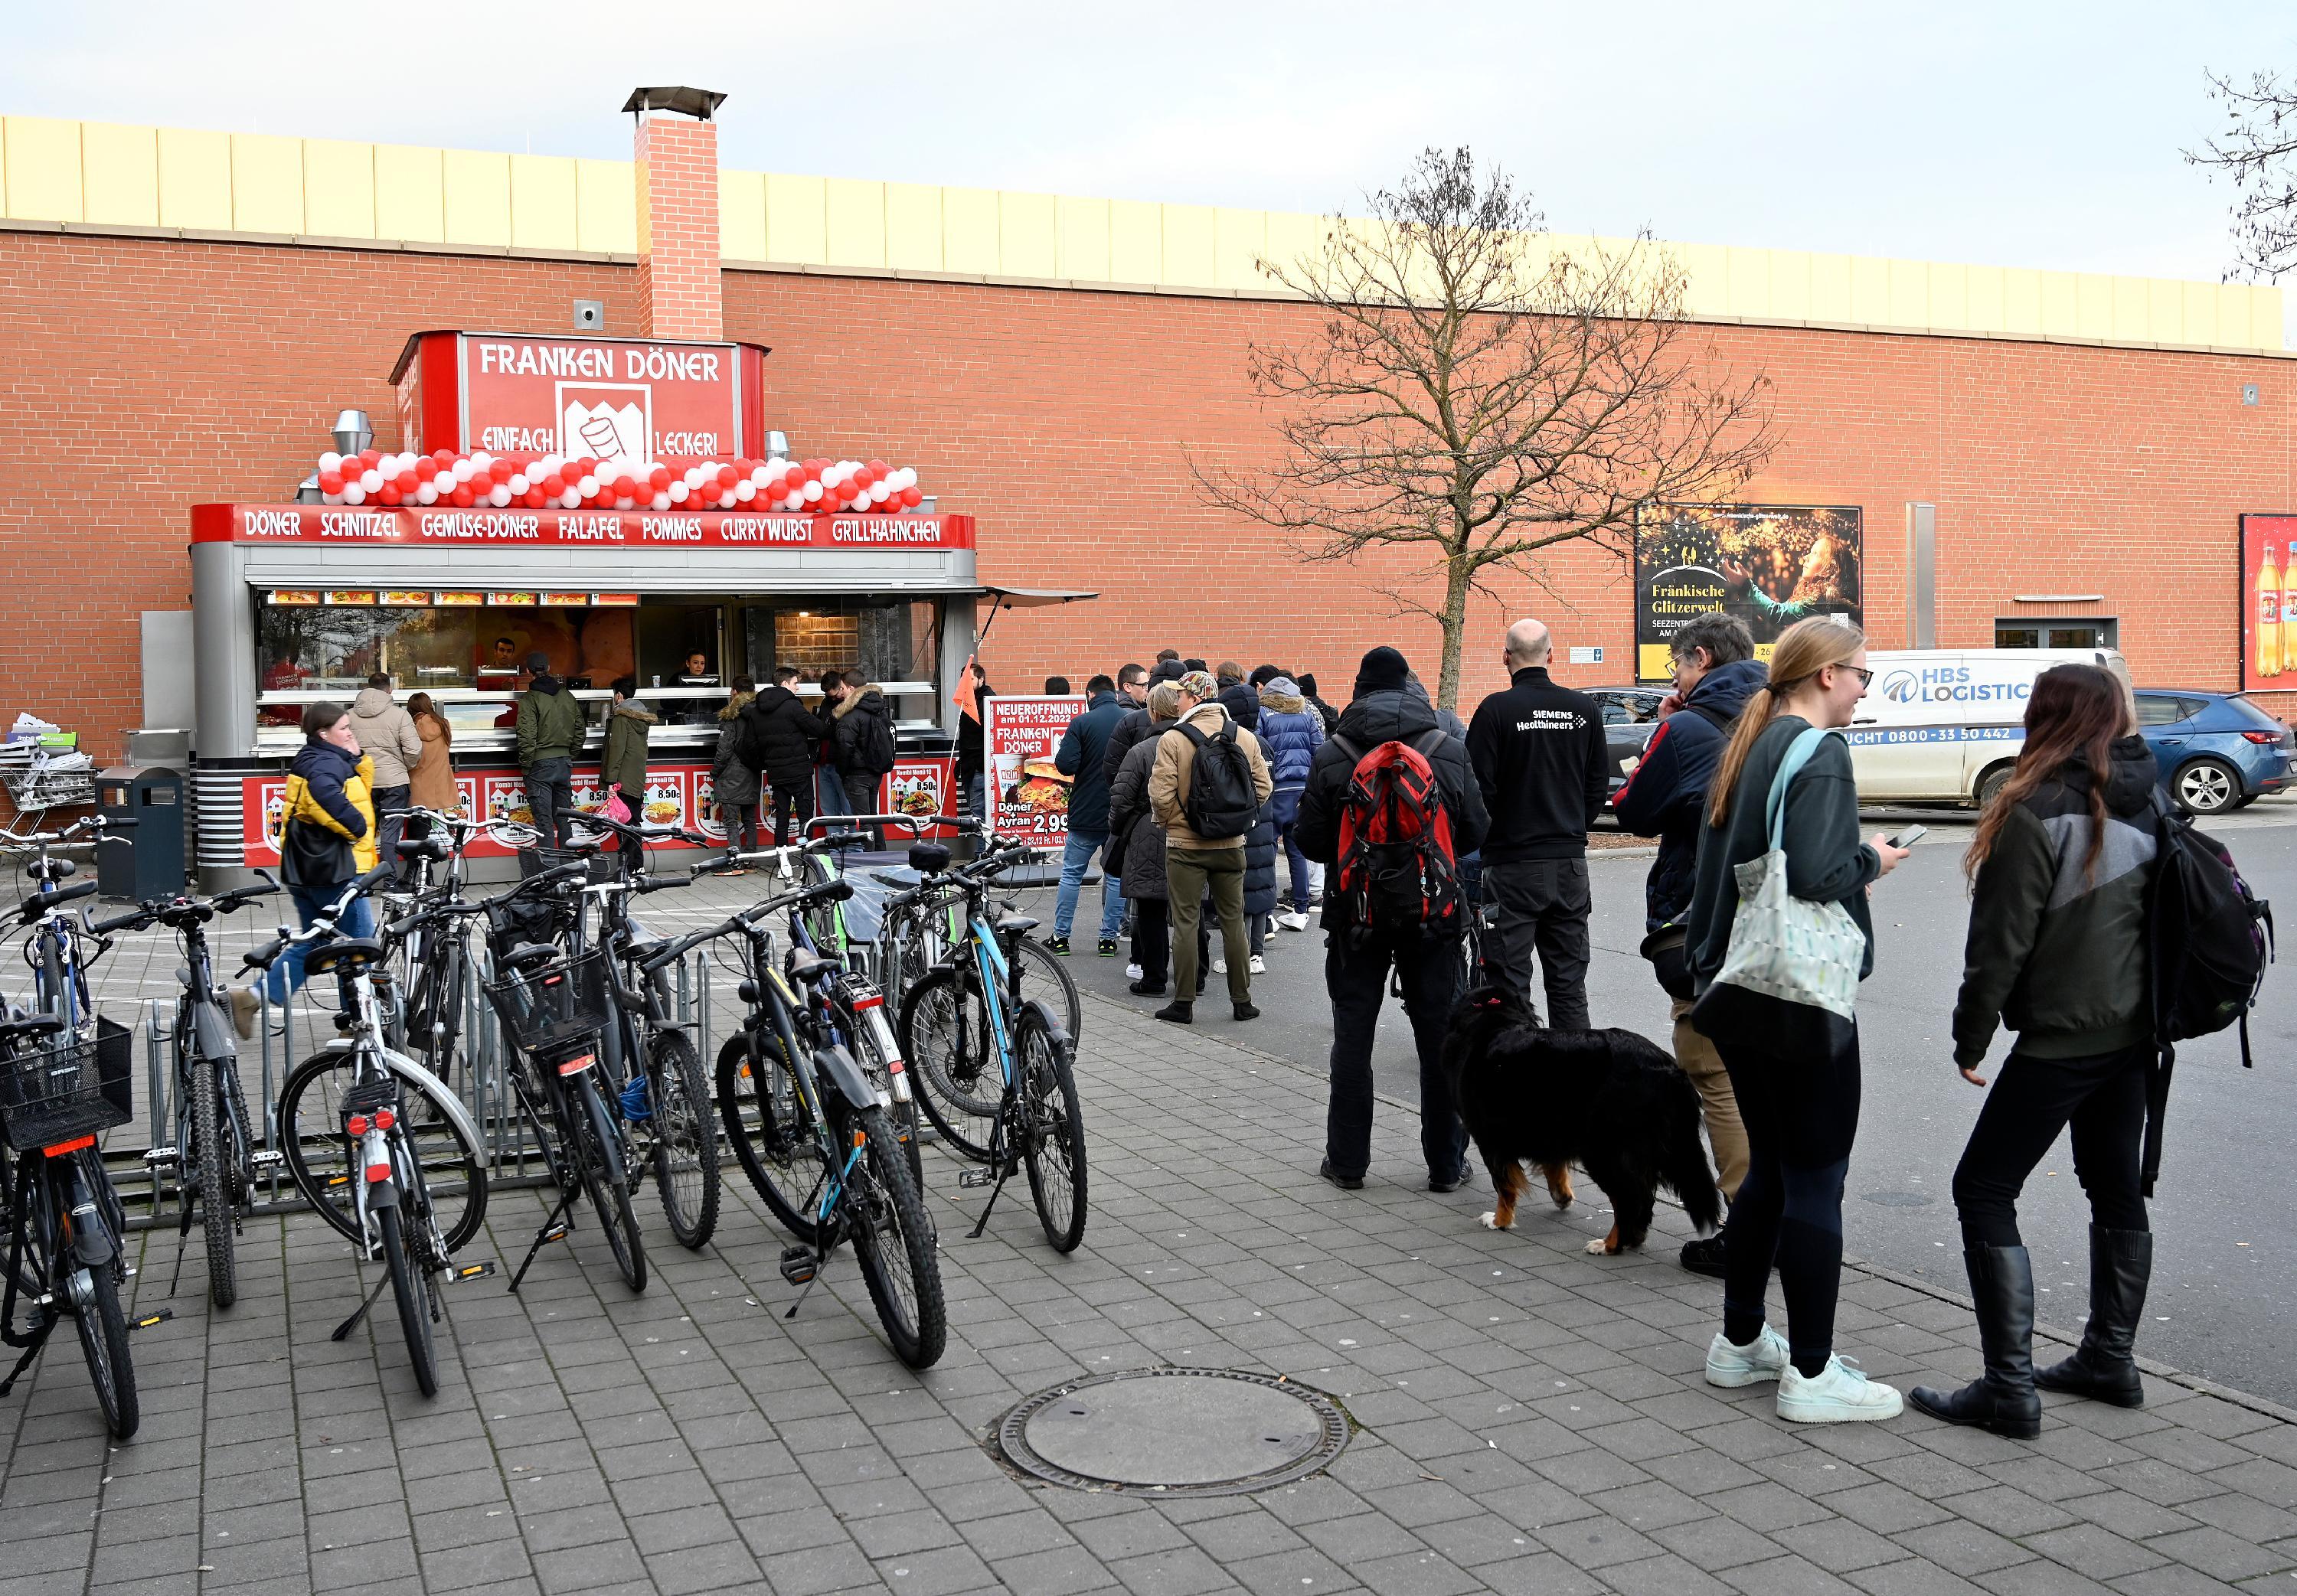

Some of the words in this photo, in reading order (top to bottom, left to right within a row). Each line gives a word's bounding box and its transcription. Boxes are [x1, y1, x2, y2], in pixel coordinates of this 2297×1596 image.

[480, 344, 613, 378] FRANKEN
[626, 346, 720, 382] DÖNER
[482, 426, 554, 453] EINFACH
[655, 431, 717, 457] LECKER!
[244, 510, 302, 536] DÖNER
[321, 512, 400, 537] SCHNITZEL
[421, 512, 539, 538] GEMÜSE-DÖNER
[557, 515, 625, 540] FALAFEL
[642, 517, 702, 540] POMMES
[720, 518, 814, 541] CURRYWURST
[832, 518, 940, 542] GRILLHÄHNCHEN
[1652, 584, 1725, 598] Fränkische
[1652, 601, 1725, 614] Glitzerwelt
[1652, 619, 1691, 628] SEEZENTR
[1922, 667, 1970, 684] HBS
[1922, 684, 2031, 702] LOGISTIC
[1018, 714, 1071, 723] 01.12.2022
[1532, 710, 1573, 720] SIEMENS
[1516, 720, 1574, 732] Healthineers
[996, 727, 1050, 740] FRANKEN
[1846, 732, 1884, 745] UCHT
[1888, 730, 1928, 743] 0800
[1938, 729, 1956, 740] 33
[1961, 728, 1979, 740] 50
[1982, 727, 2010, 739] 442
[1004, 740, 1042, 754] DÖNER
[998, 802, 1033, 812] Döner
[997, 816, 1031, 828] Ayran
